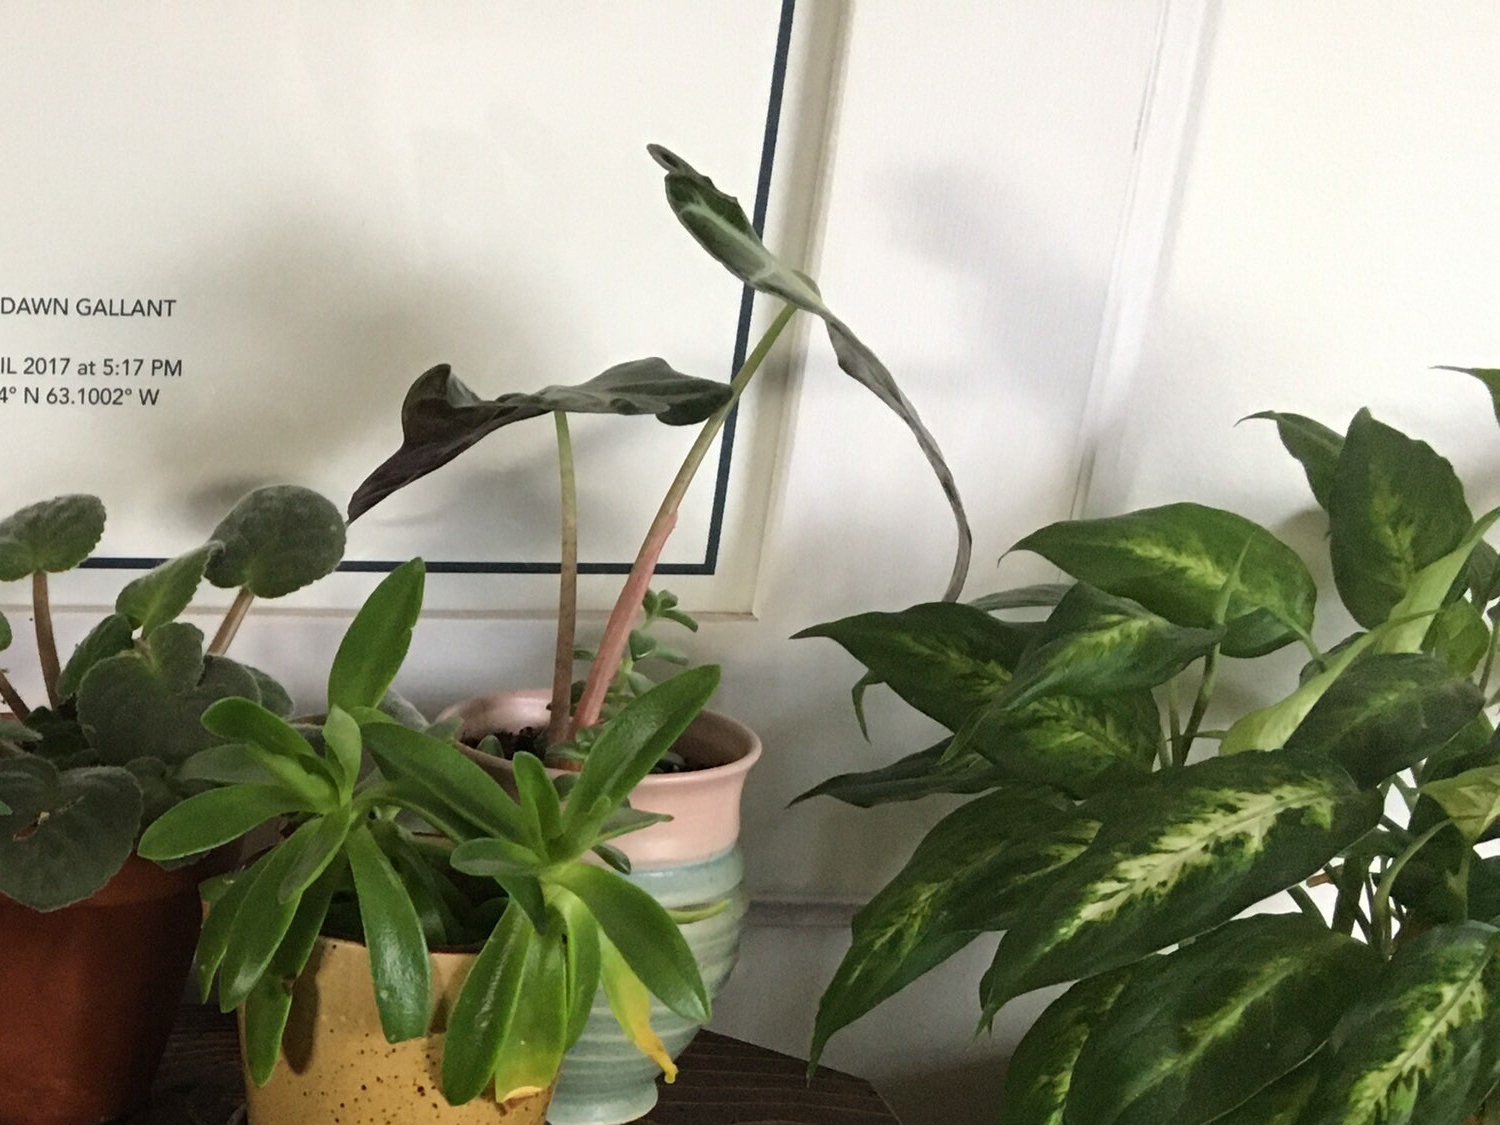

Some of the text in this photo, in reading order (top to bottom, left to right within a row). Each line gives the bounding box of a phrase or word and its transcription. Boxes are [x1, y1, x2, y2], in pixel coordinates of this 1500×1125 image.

[0, 297, 69, 316] DAWN
[75, 298, 178, 318] GALLANT
[23, 357, 71, 375] 2017
[77, 359, 97, 376] at
[102, 358, 145, 377] 5:17
[151, 359, 183, 377] PM
[23, 386, 40, 404] N
[138, 388, 161, 406] W
